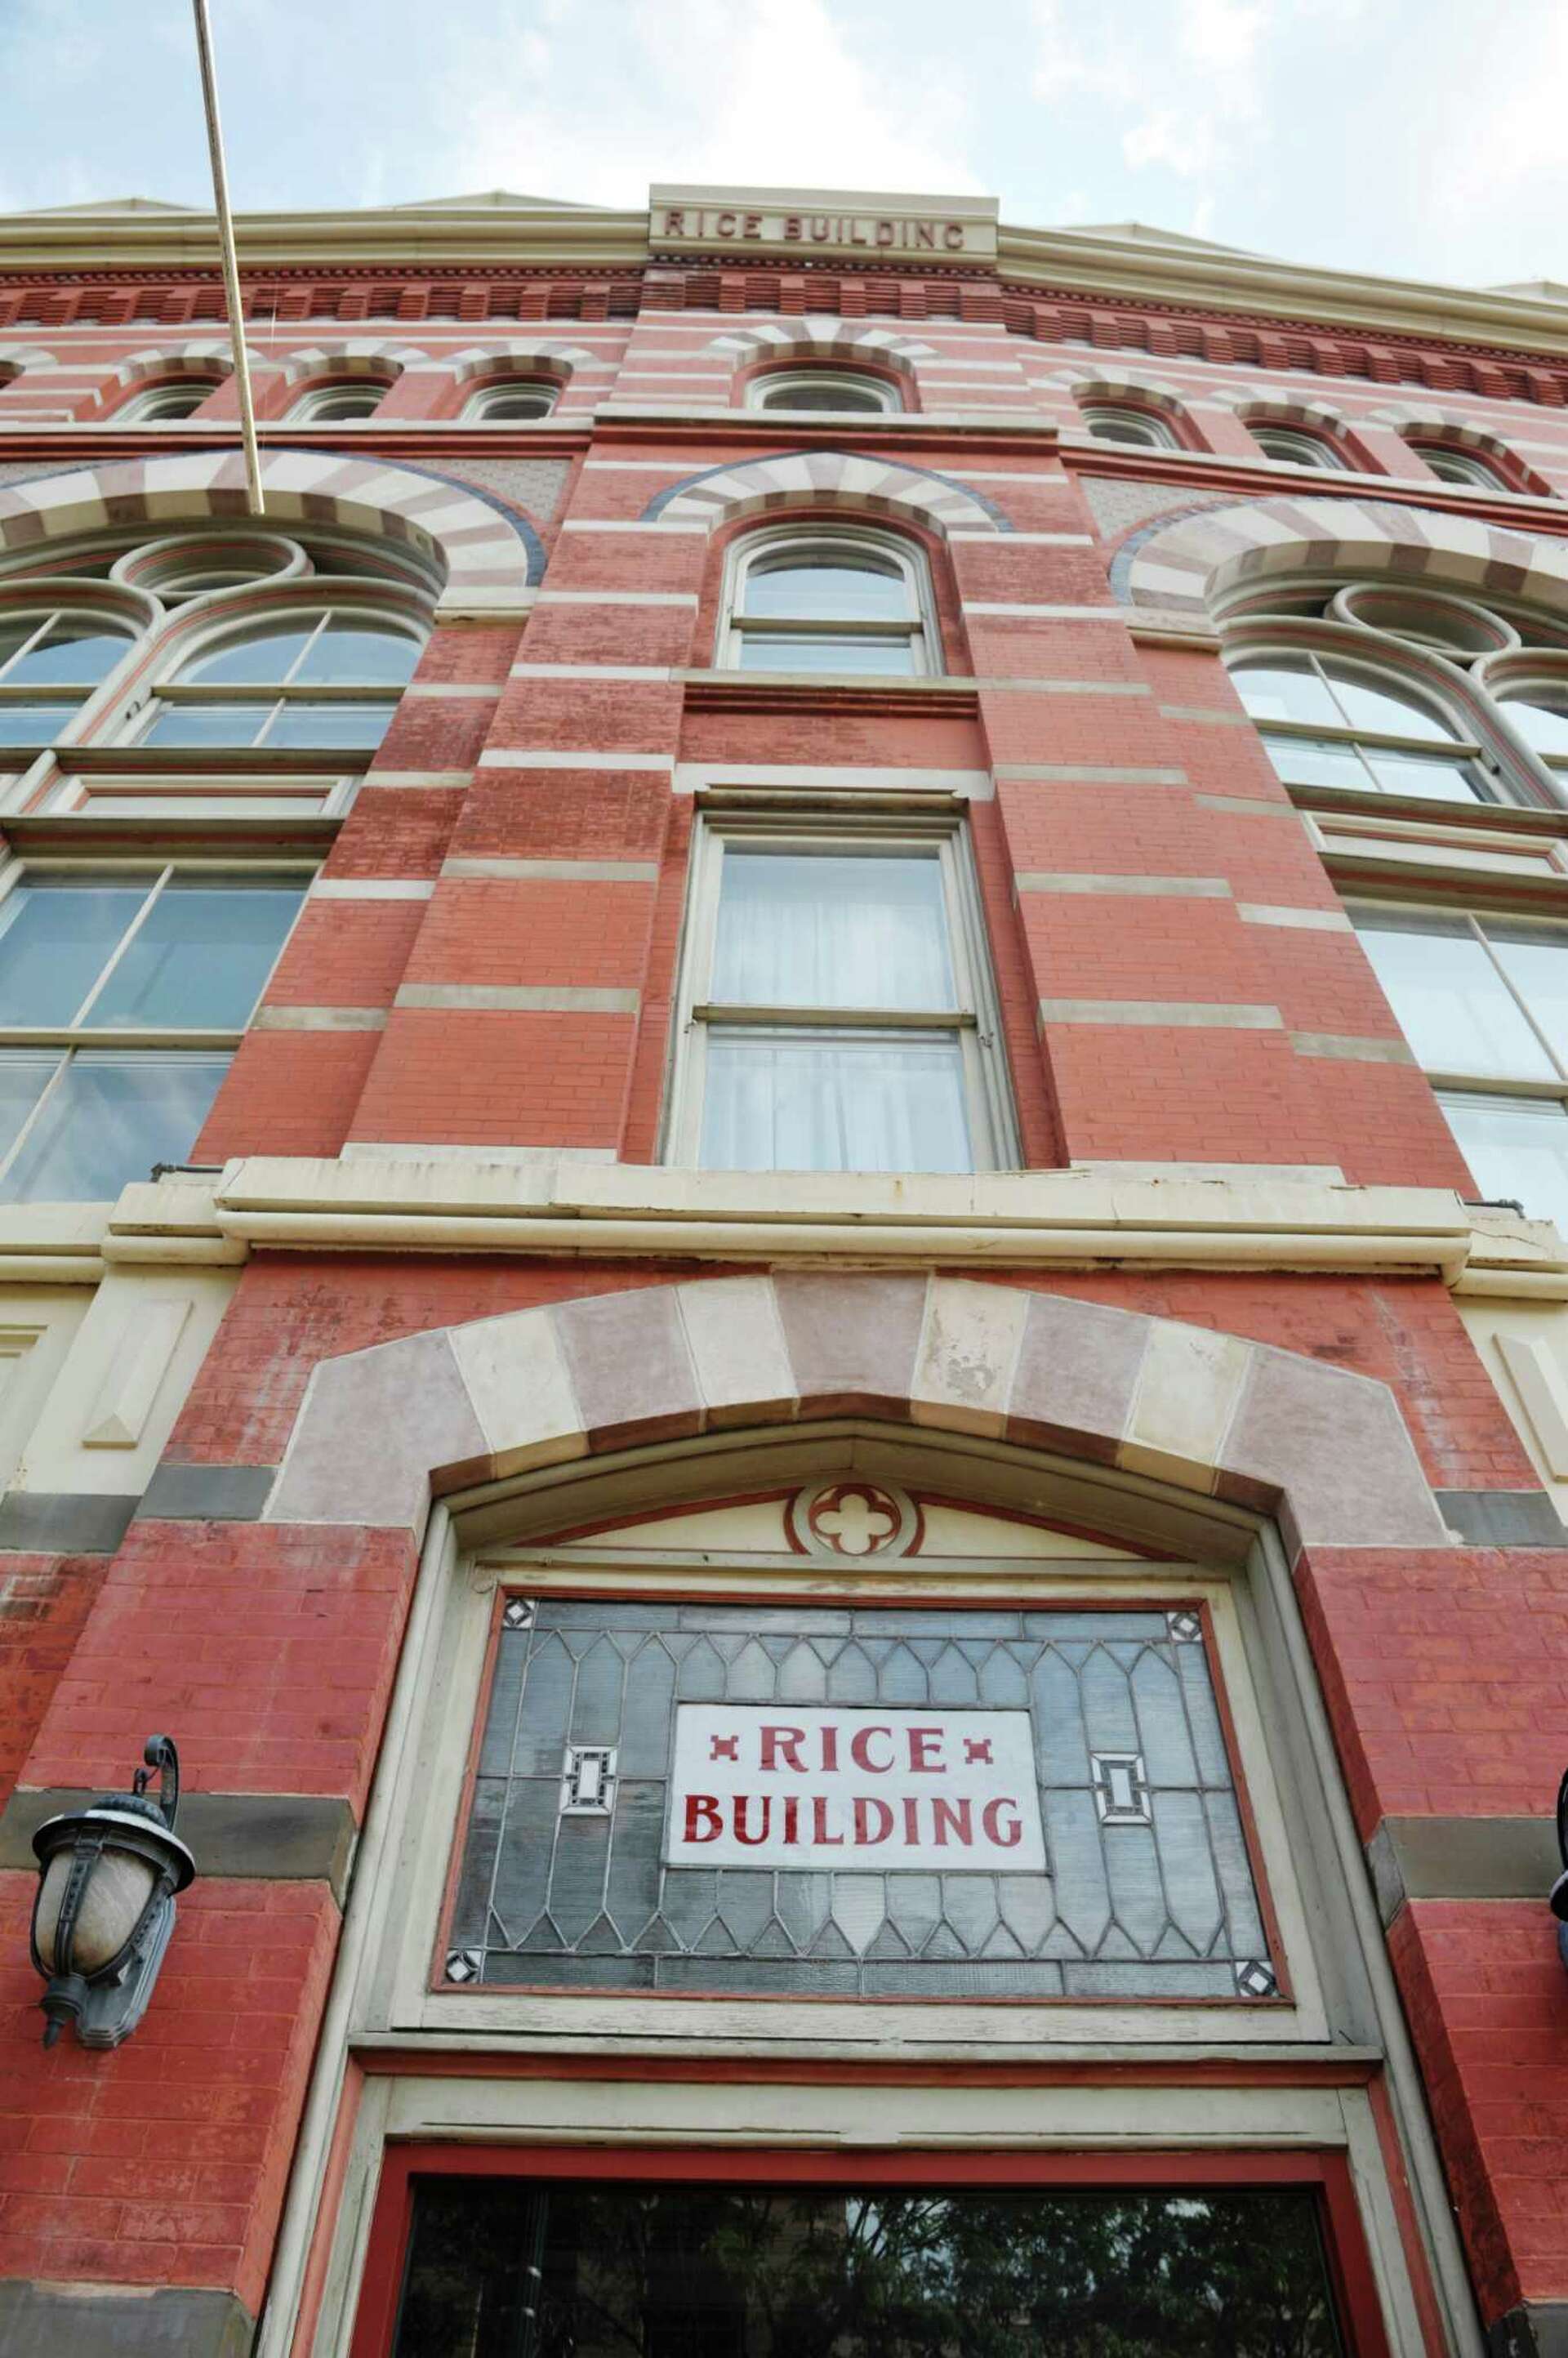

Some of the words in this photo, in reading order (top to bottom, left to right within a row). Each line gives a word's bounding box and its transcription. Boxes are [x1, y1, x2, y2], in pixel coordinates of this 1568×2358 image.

[665, 210, 763, 239] RICE
[784, 216, 964, 250] BUILDING
[759, 1726, 947, 1774] RICE
[682, 1794, 1022, 1848] BUILDING
